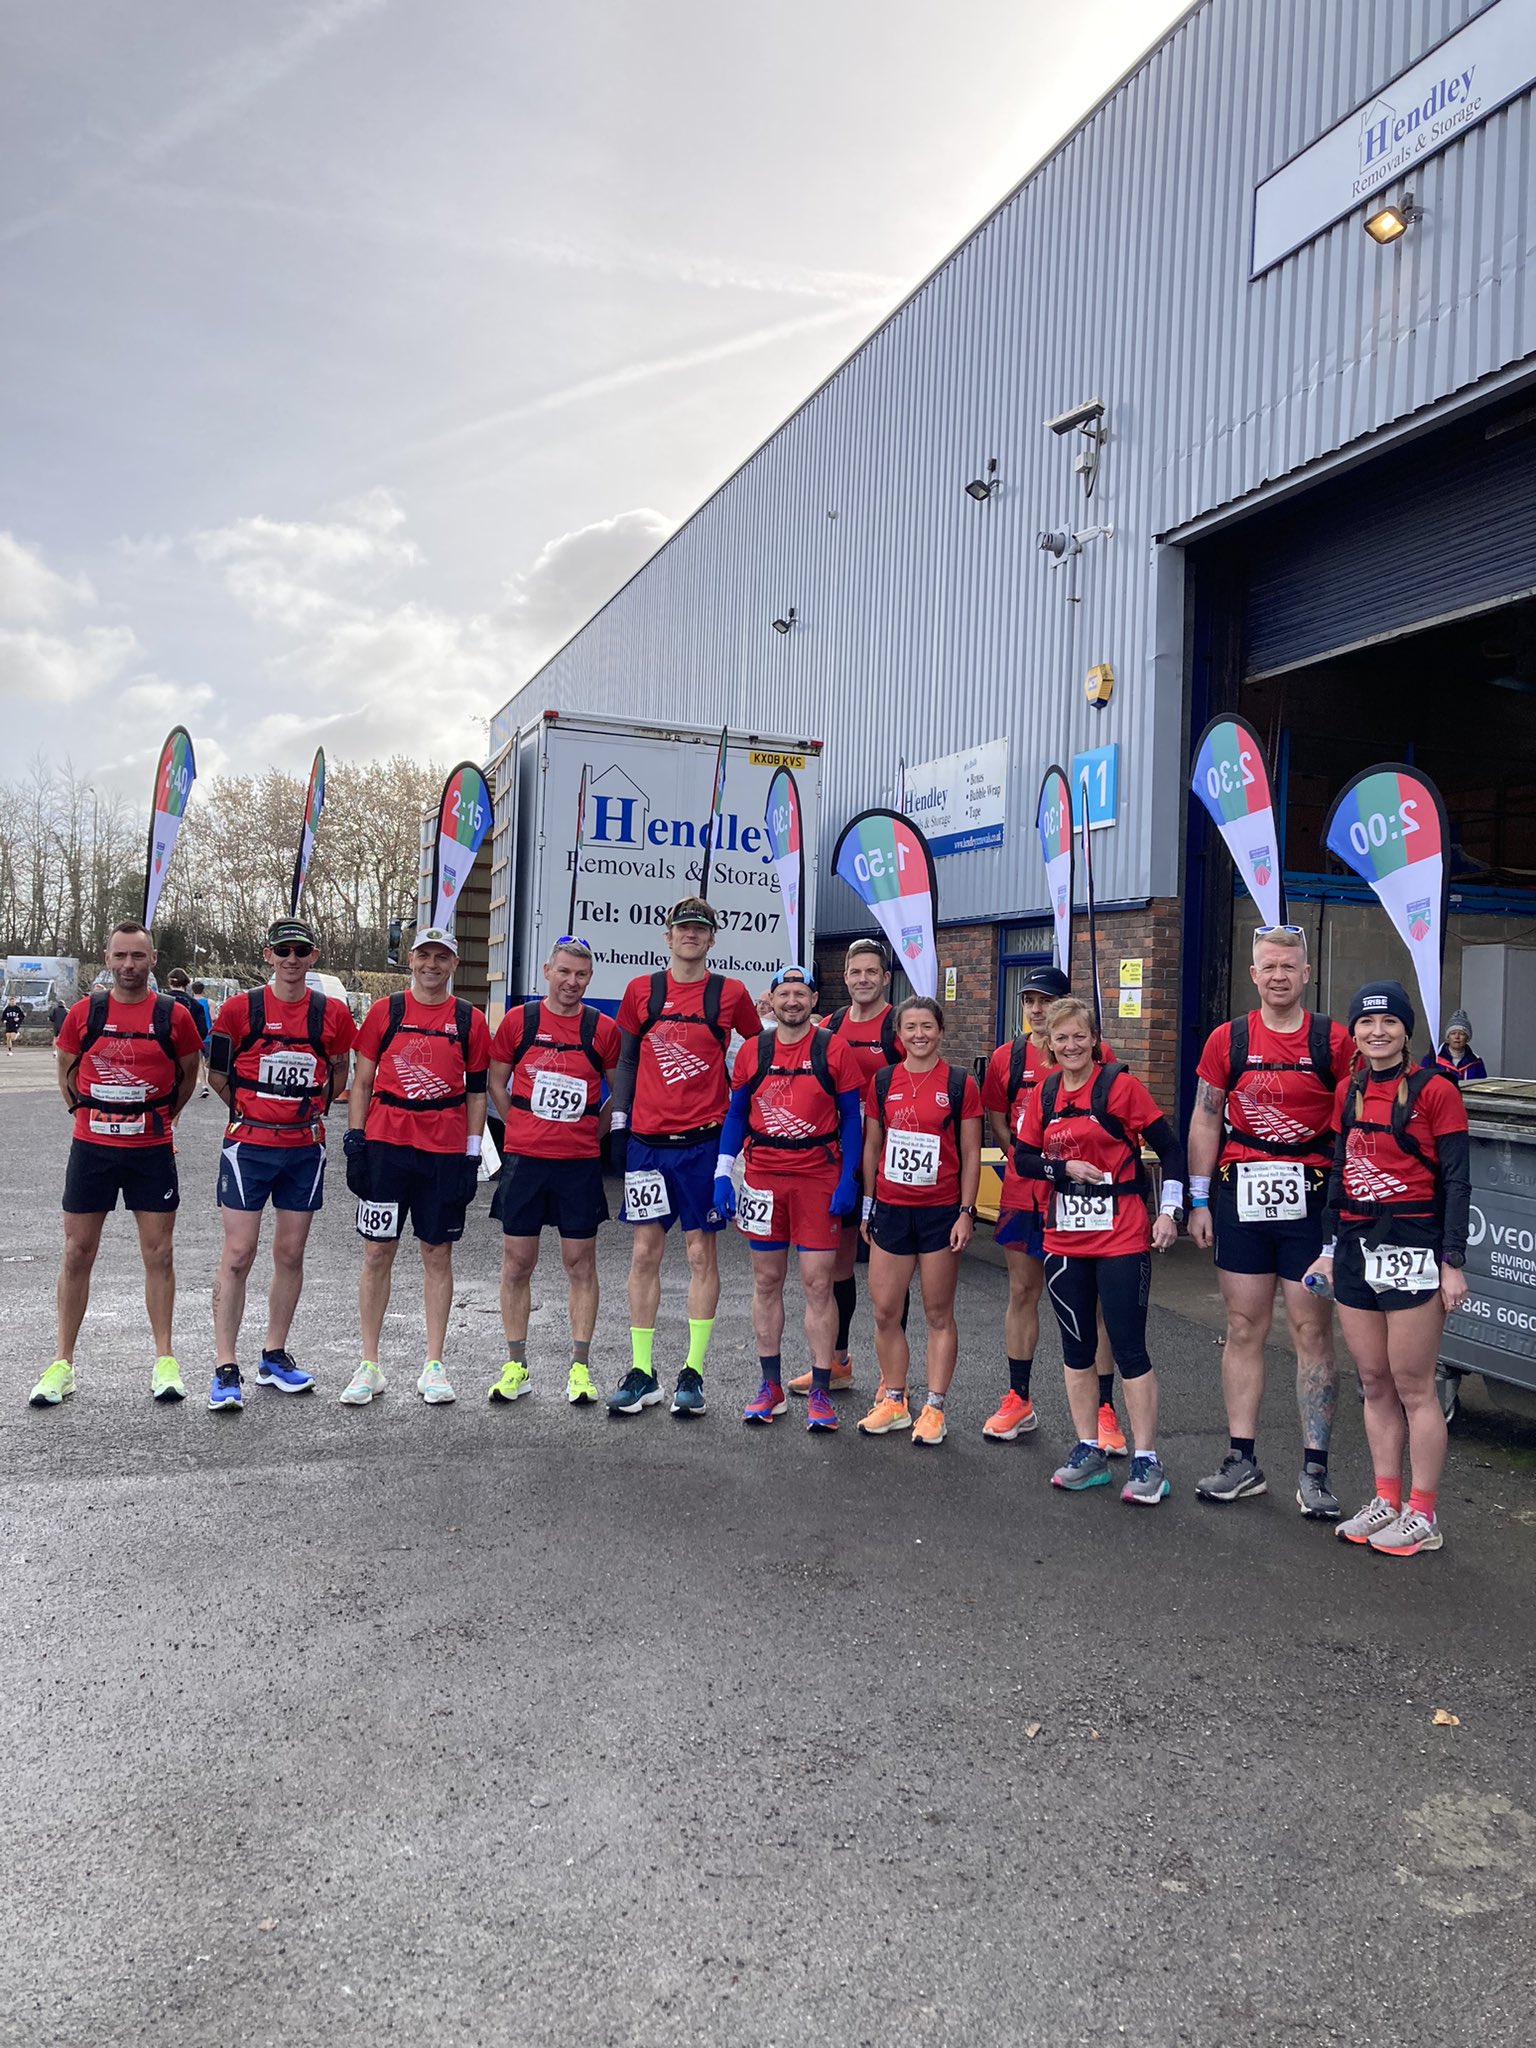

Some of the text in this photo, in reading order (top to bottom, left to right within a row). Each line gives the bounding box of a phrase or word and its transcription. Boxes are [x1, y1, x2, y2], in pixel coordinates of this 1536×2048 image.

[1363, 64, 1477, 165] Hendley
[1352, 97, 1482, 198] Removals & Storage
[754, 753, 802, 767] KX08 KVS
[451, 790, 483, 831] 2:15
[904, 786, 948, 814] Hendley
[714, 863, 781, 893] Storag
[577, 900, 619, 923] Tel:
[1362, 998, 1388, 1007] TRIBE
[267, 1065, 310, 1088] 1485
[539, 1087, 582, 1112] 1359
[891, 1146, 933, 1174] 1354
[625, 1183, 663, 1208] 1362
[1062, 1193, 1107, 1216] 1583
[1247, 1179, 1300, 1206] 1353
[360, 1204, 393, 1231] 1489
[738, 1194, 768, 1222] 1352
[1489, 1223, 1536, 1253] VEO
[1375, 1250, 1428, 1279] 1397
